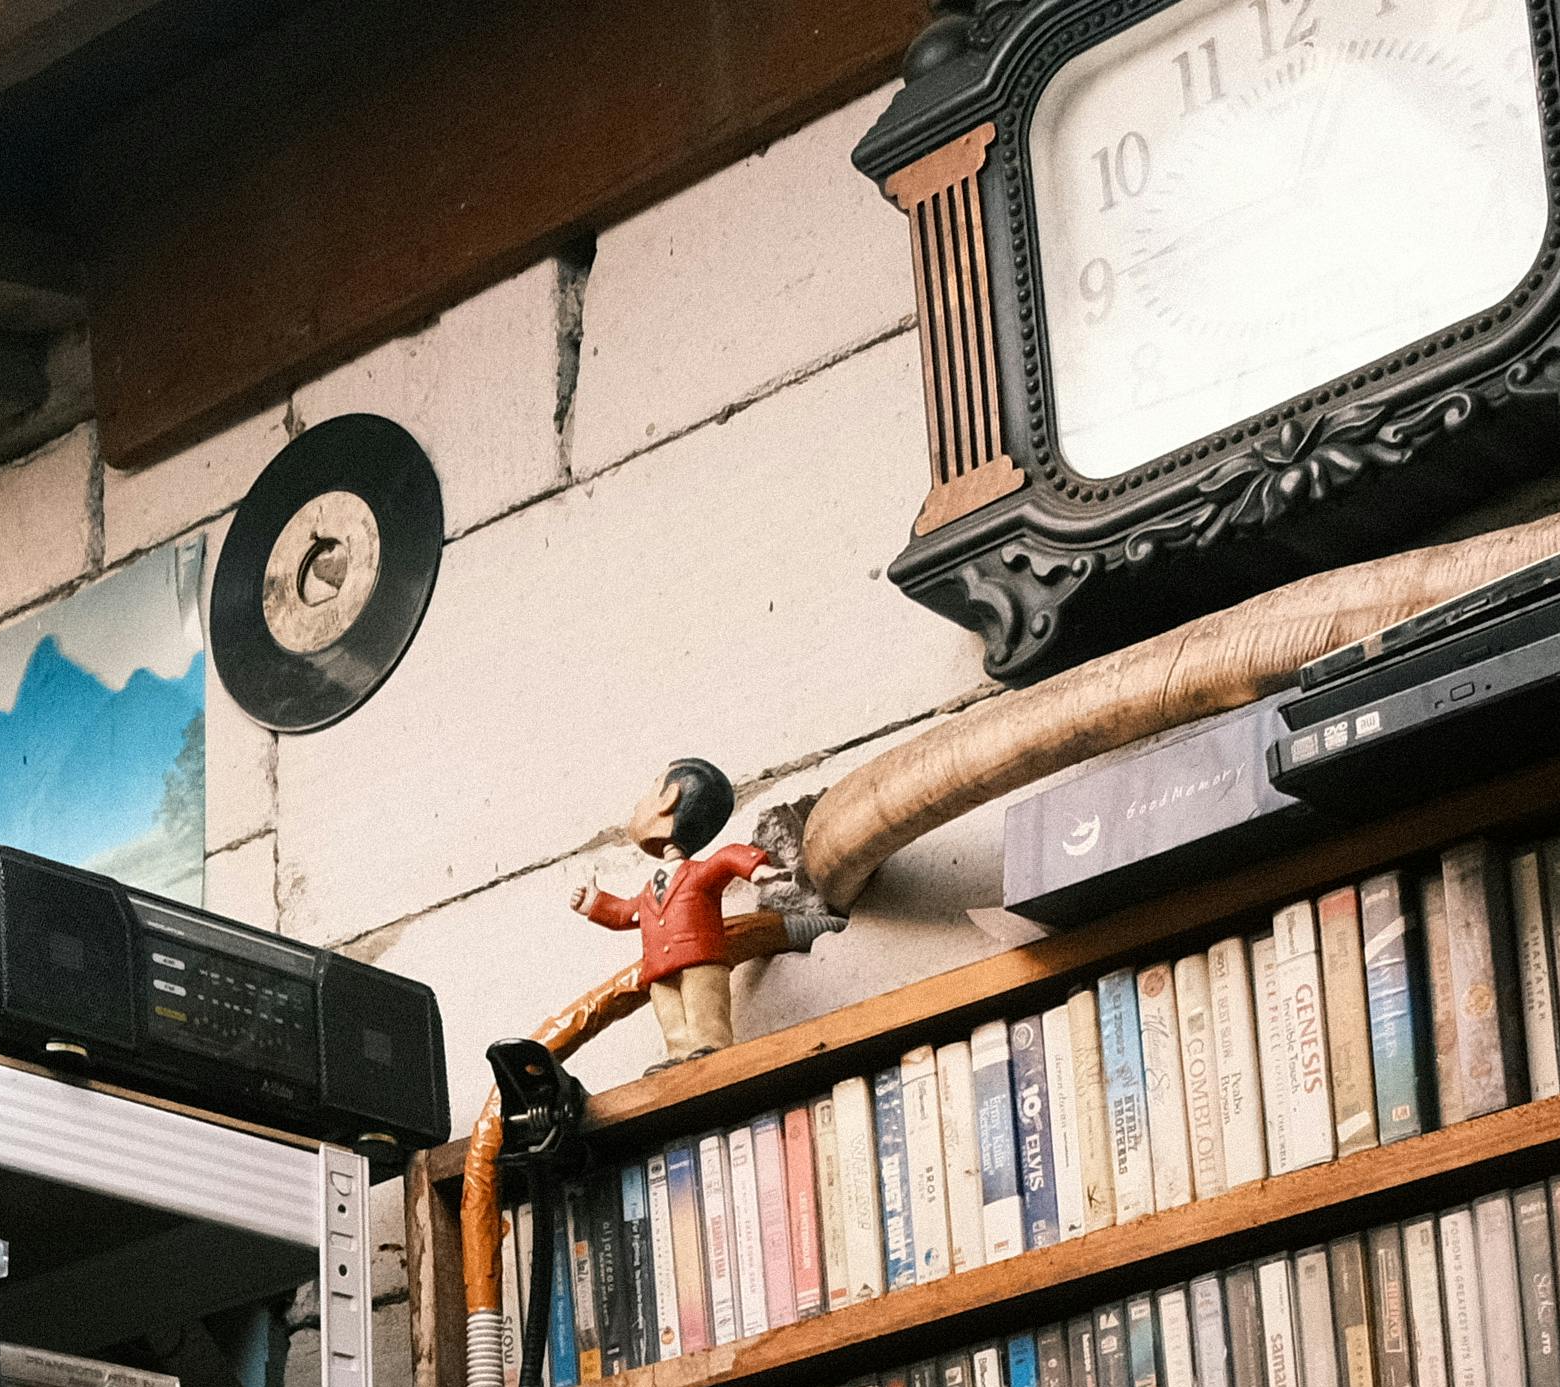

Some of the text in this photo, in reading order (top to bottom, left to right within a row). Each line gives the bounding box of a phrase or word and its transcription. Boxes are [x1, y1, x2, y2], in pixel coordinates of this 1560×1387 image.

[1172, 36, 1228, 118] 11
[1091, 132, 1150, 213] 10
[1078, 258, 1116, 325] 9
[1282, 997, 1300, 1094] Invisible Touch
[1296, 984, 1323, 1094] GENESIS
[1123, 1094, 1138, 1151] EVERLY
[1231, 1072, 1243, 1115] Peabo
[1113, 1098, 1128, 1176] BROTHERS
